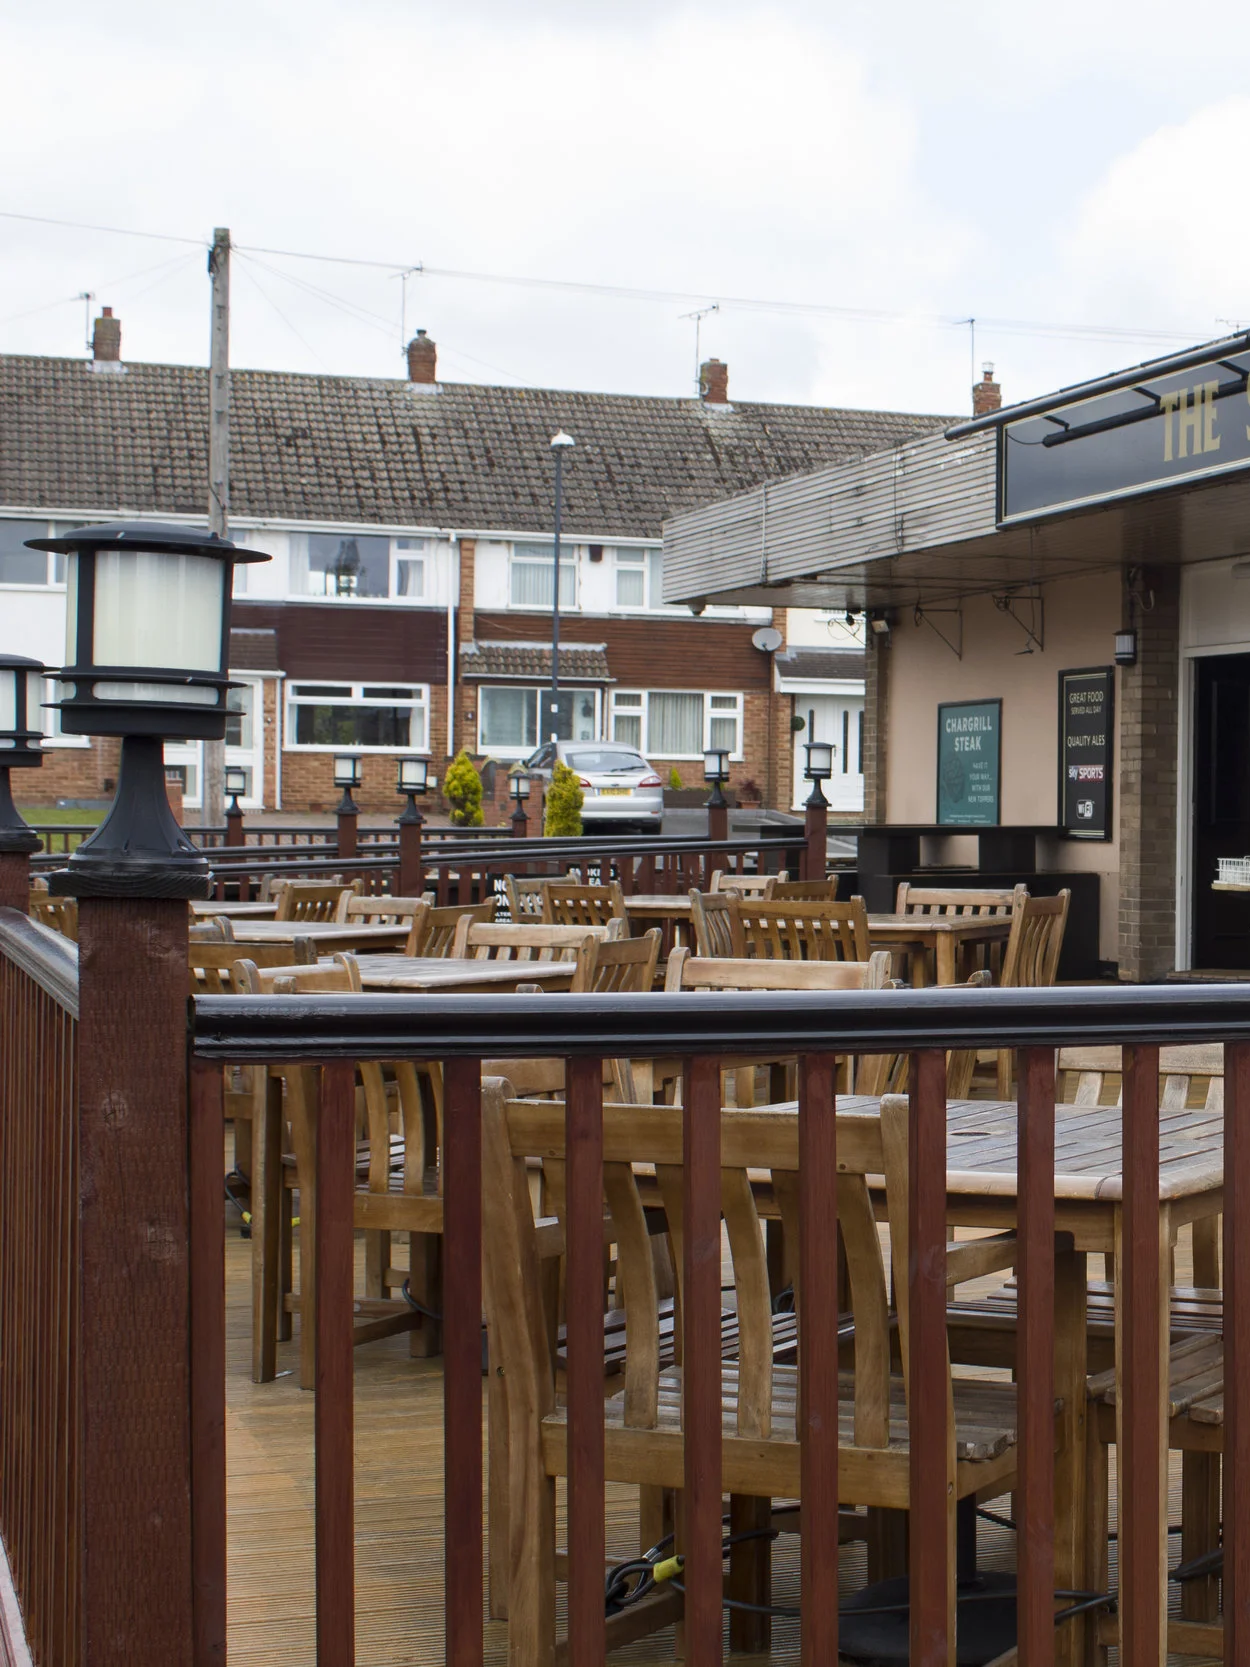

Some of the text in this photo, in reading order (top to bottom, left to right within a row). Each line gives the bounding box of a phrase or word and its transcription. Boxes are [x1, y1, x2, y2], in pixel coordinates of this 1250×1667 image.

[1160, 380, 1221, 462] THE
[1069, 691, 1104, 704] GREAT FOOD
[1071, 706, 1085, 715] SERVED
[1093, 705, 1102, 714] DAY
[945, 716, 992, 733] CHARGRILL
[954, 736, 981, 752] STEAK
[1067, 735, 1105, 748] QUALITY ALES
[1069, 766, 1104, 780] sky SPORTS
